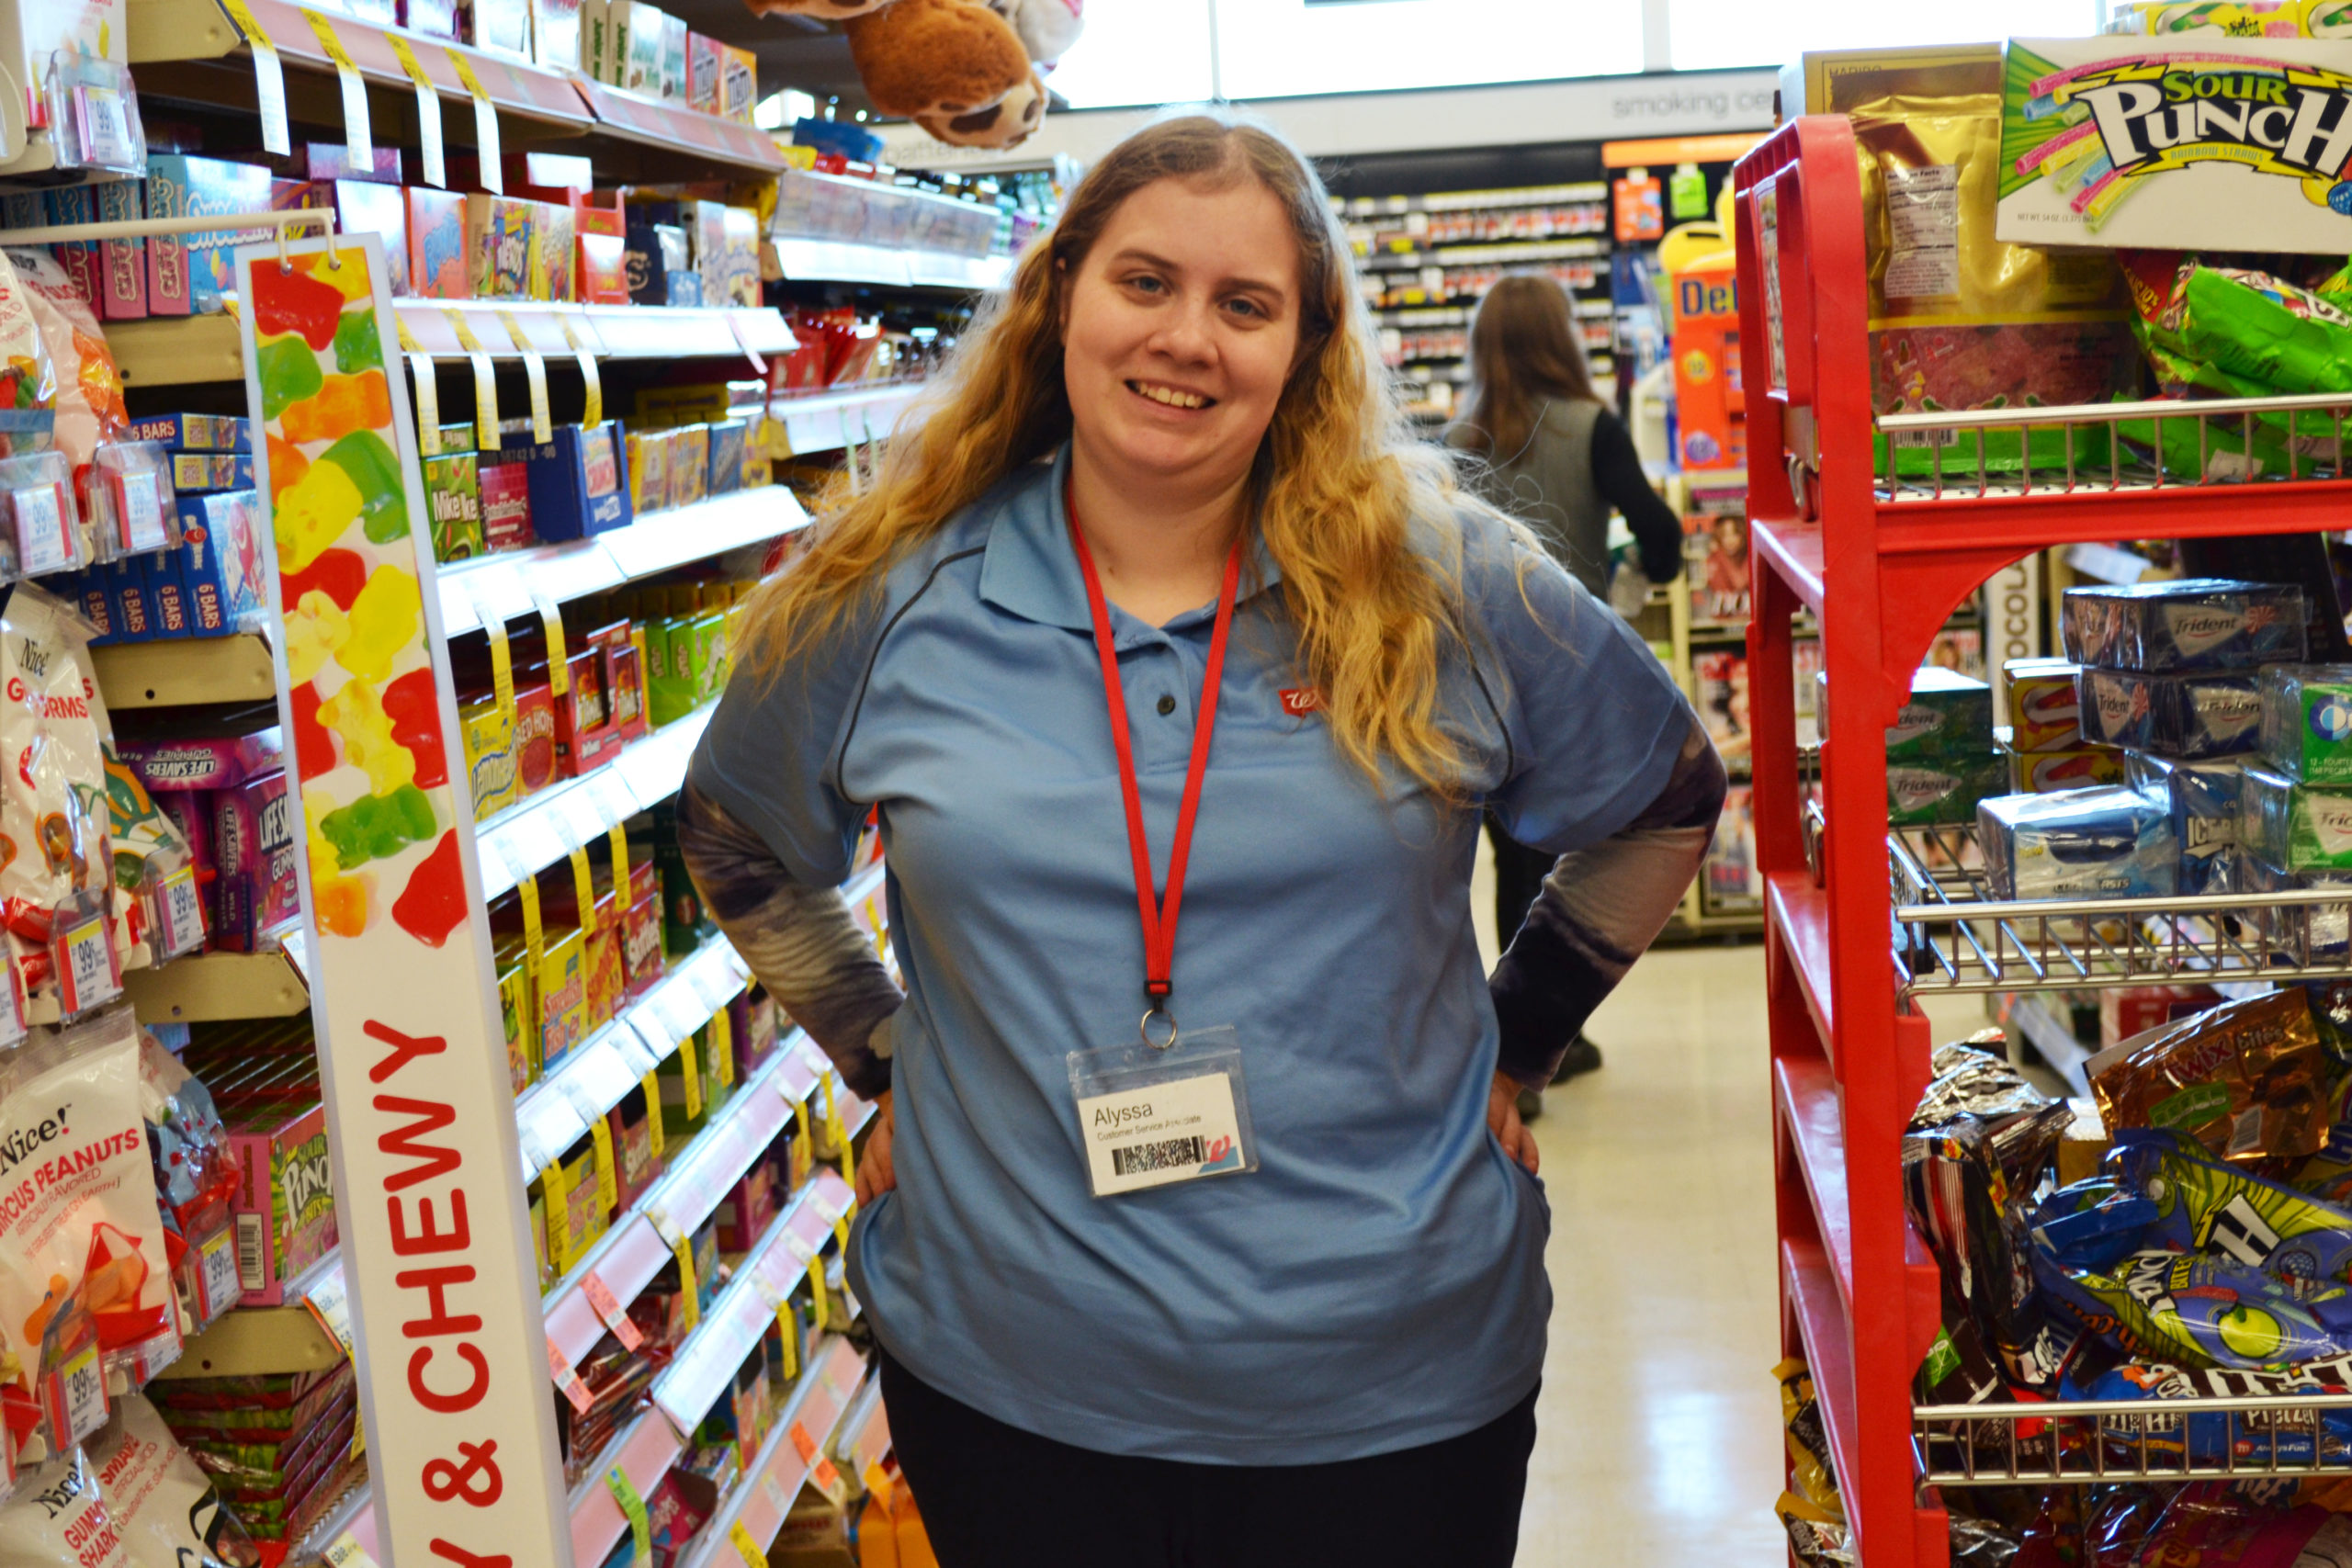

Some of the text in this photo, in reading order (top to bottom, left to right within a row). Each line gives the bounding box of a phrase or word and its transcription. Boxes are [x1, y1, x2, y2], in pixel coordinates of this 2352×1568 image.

[2162, 71, 2289, 105] SOUR
[1612, 93, 1728, 119] smoking
[2075, 83, 2352, 178] PUNCH
[2170, 146, 2264, 161] RAINBOW STRAWS
[132, 419, 176, 441] 6 BARS
[432, 489, 459, 523] Mike
[125, 598, 147, 634] BARS
[163, 595, 184, 632] BARS
[199, 593, 221, 631] BARS
[2174, 616, 2239, 633] Trident
[2098, 694, 2130, 714] Trident
[2207, 700, 2260, 713] Triden
[516, 716, 532, 744] RED
[1898, 712, 1936, 725] dent
[1895, 779, 1952, 794] Trident
[2235, 1023, 2286, 1050] bites
[1094, 1102, 1153, 1128] Alyssa
[0, 1107, 70, 1177] Nice!
[1097, 1127, 1133, 1141] Customer
[1135, 1122, 1163, 1134] Service
[34, 1127, 141, 1194] PEANUTS
[48, 1167, 102, 1203] FLAVORED
[363, 1019, 491, 1414] CHEWY
[422, 1438, 503, 1508] &
